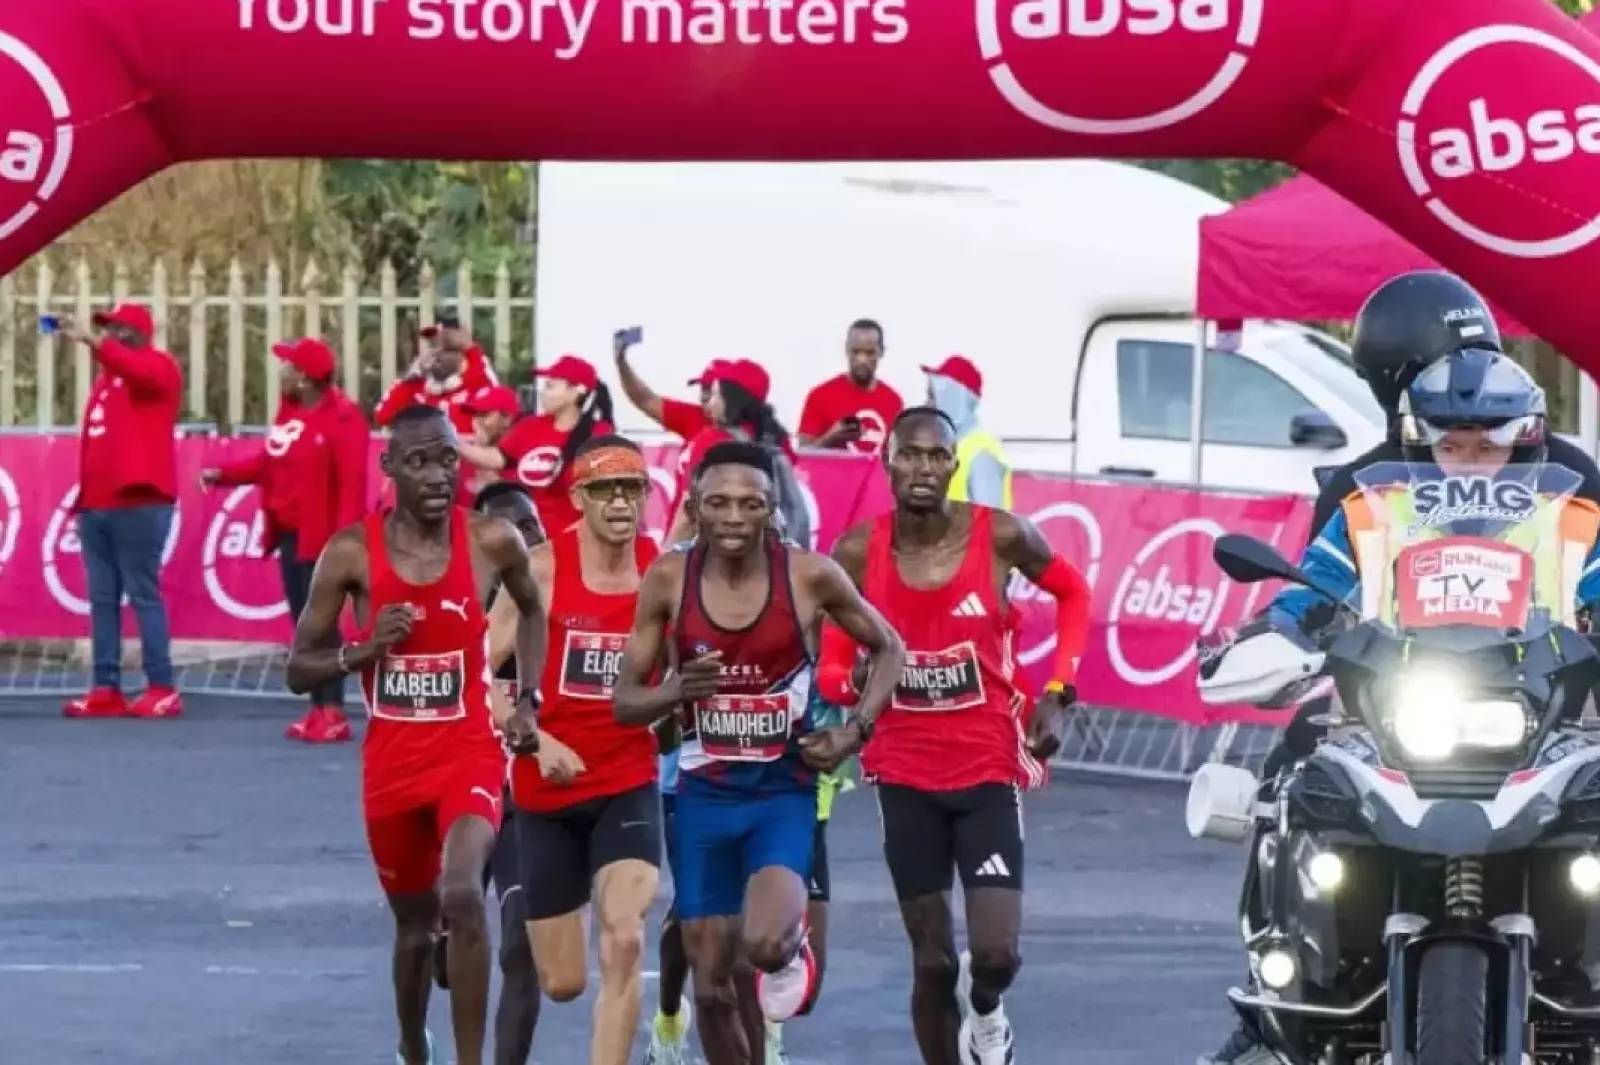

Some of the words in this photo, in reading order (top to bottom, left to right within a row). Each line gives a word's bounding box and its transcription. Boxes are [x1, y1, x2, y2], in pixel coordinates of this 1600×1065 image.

[408, 0, 597, 59] story
[621, 0, 909, 44] matters
[1429, 98, 1600, 178] absa
[1414, 477, 1534, 514] SMG
[1125, 564, 1213, 624] absa
[1423, 596, 1503, 617] MEDIA
[384, 670, 453, 696] KABELO
[701, 709, 787, 736] KAMOHELO
